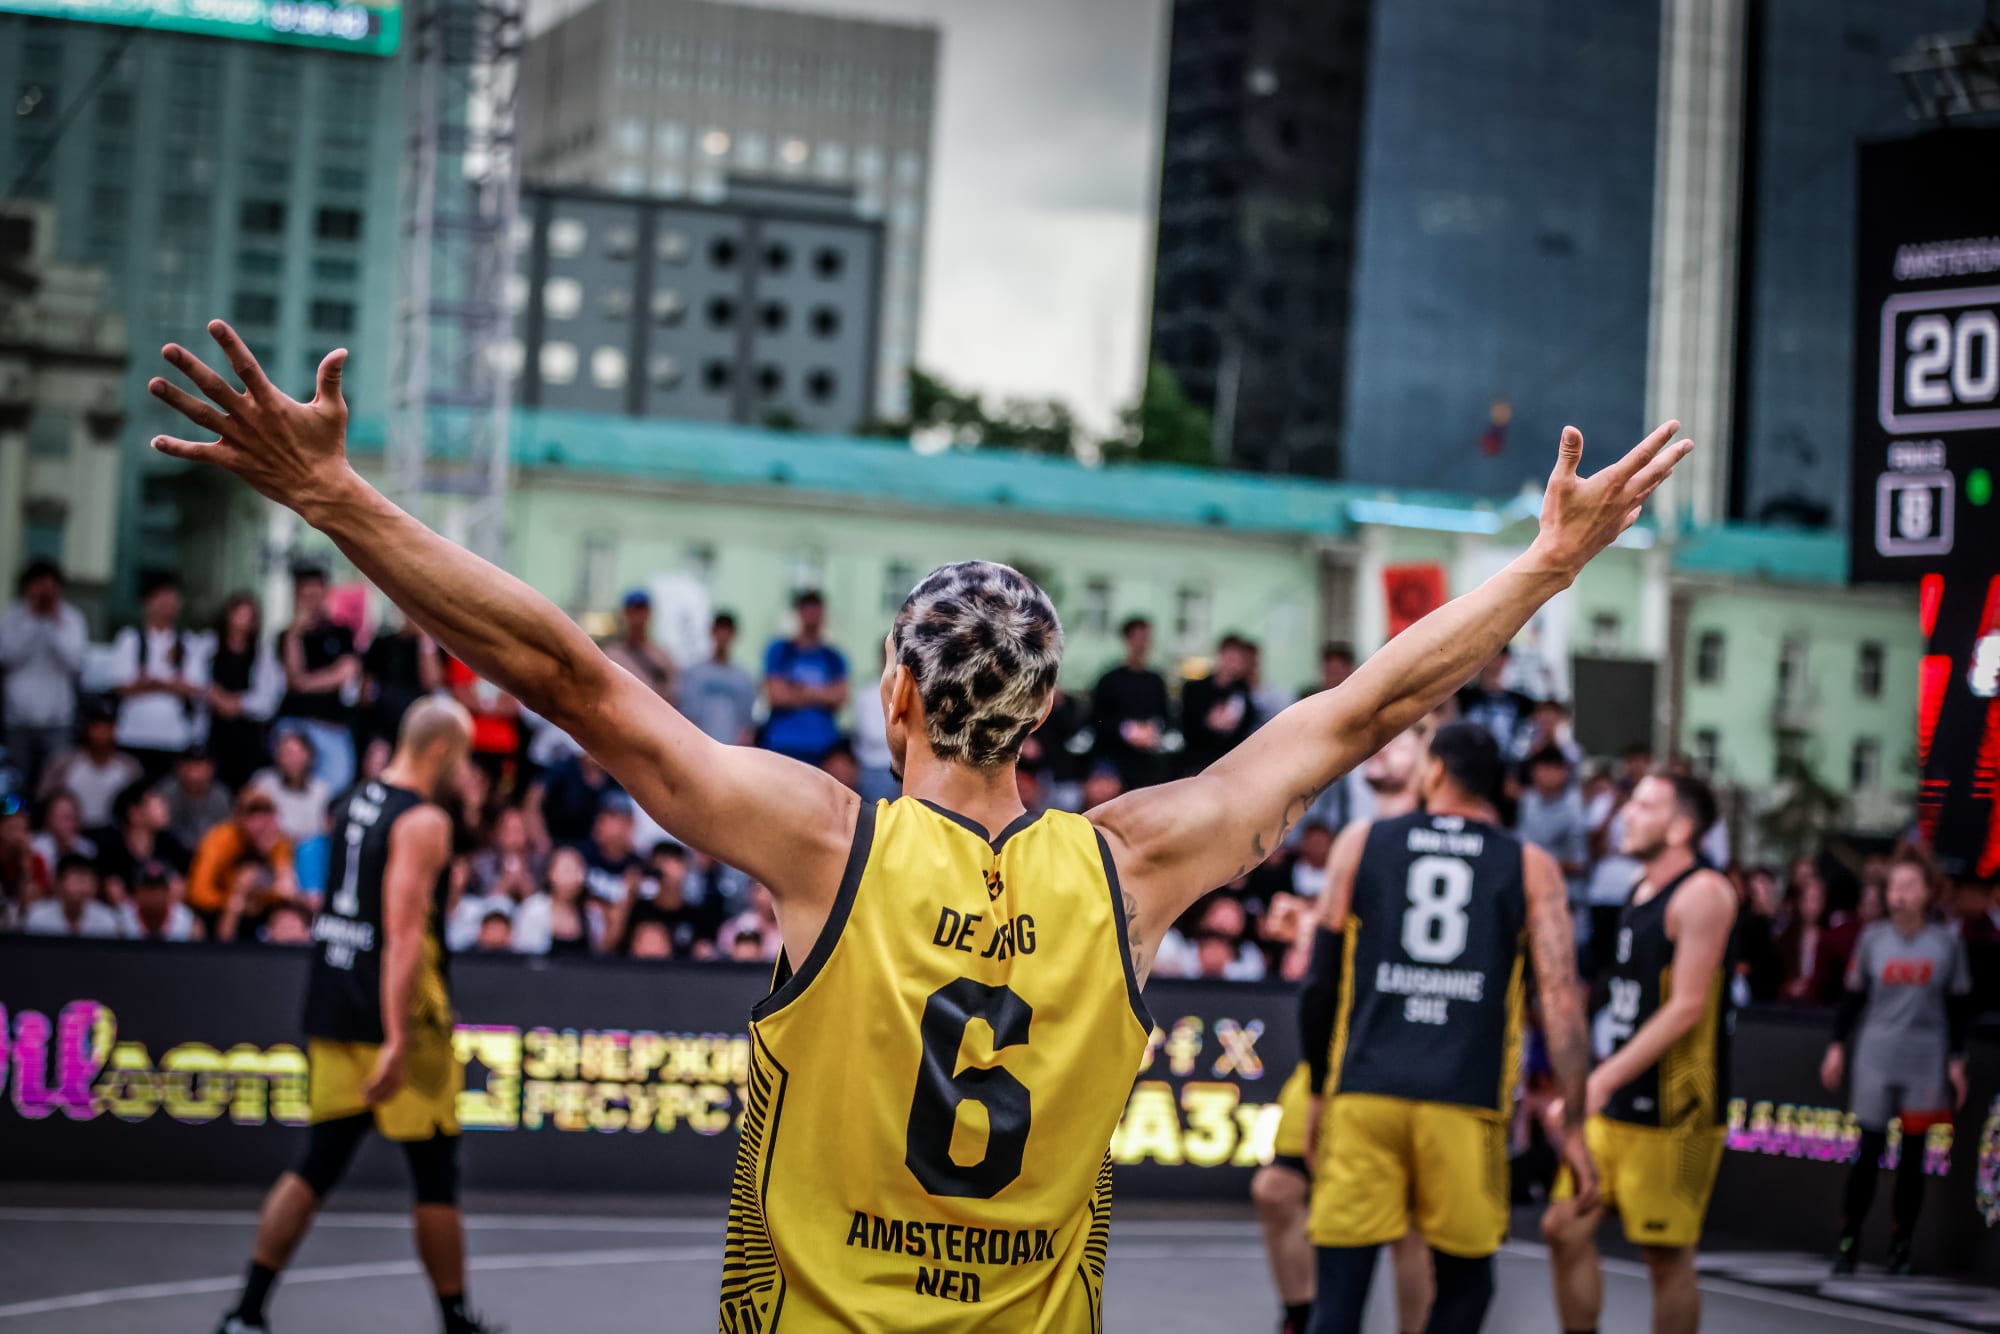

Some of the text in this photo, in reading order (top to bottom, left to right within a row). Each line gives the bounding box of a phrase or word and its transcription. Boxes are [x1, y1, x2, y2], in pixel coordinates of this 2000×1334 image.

[1904, 310, 2000, 407] 20
[932, 906, 982, 953] DE
[1401, 855, 1474, 964] 8
[1375, 962, 1485, 1003] LAUSANNE
[0, 999, 312, 1127] ilson
[905, 977, 1033, 1199] 6
[915, 1266, 981, 1303] NED
